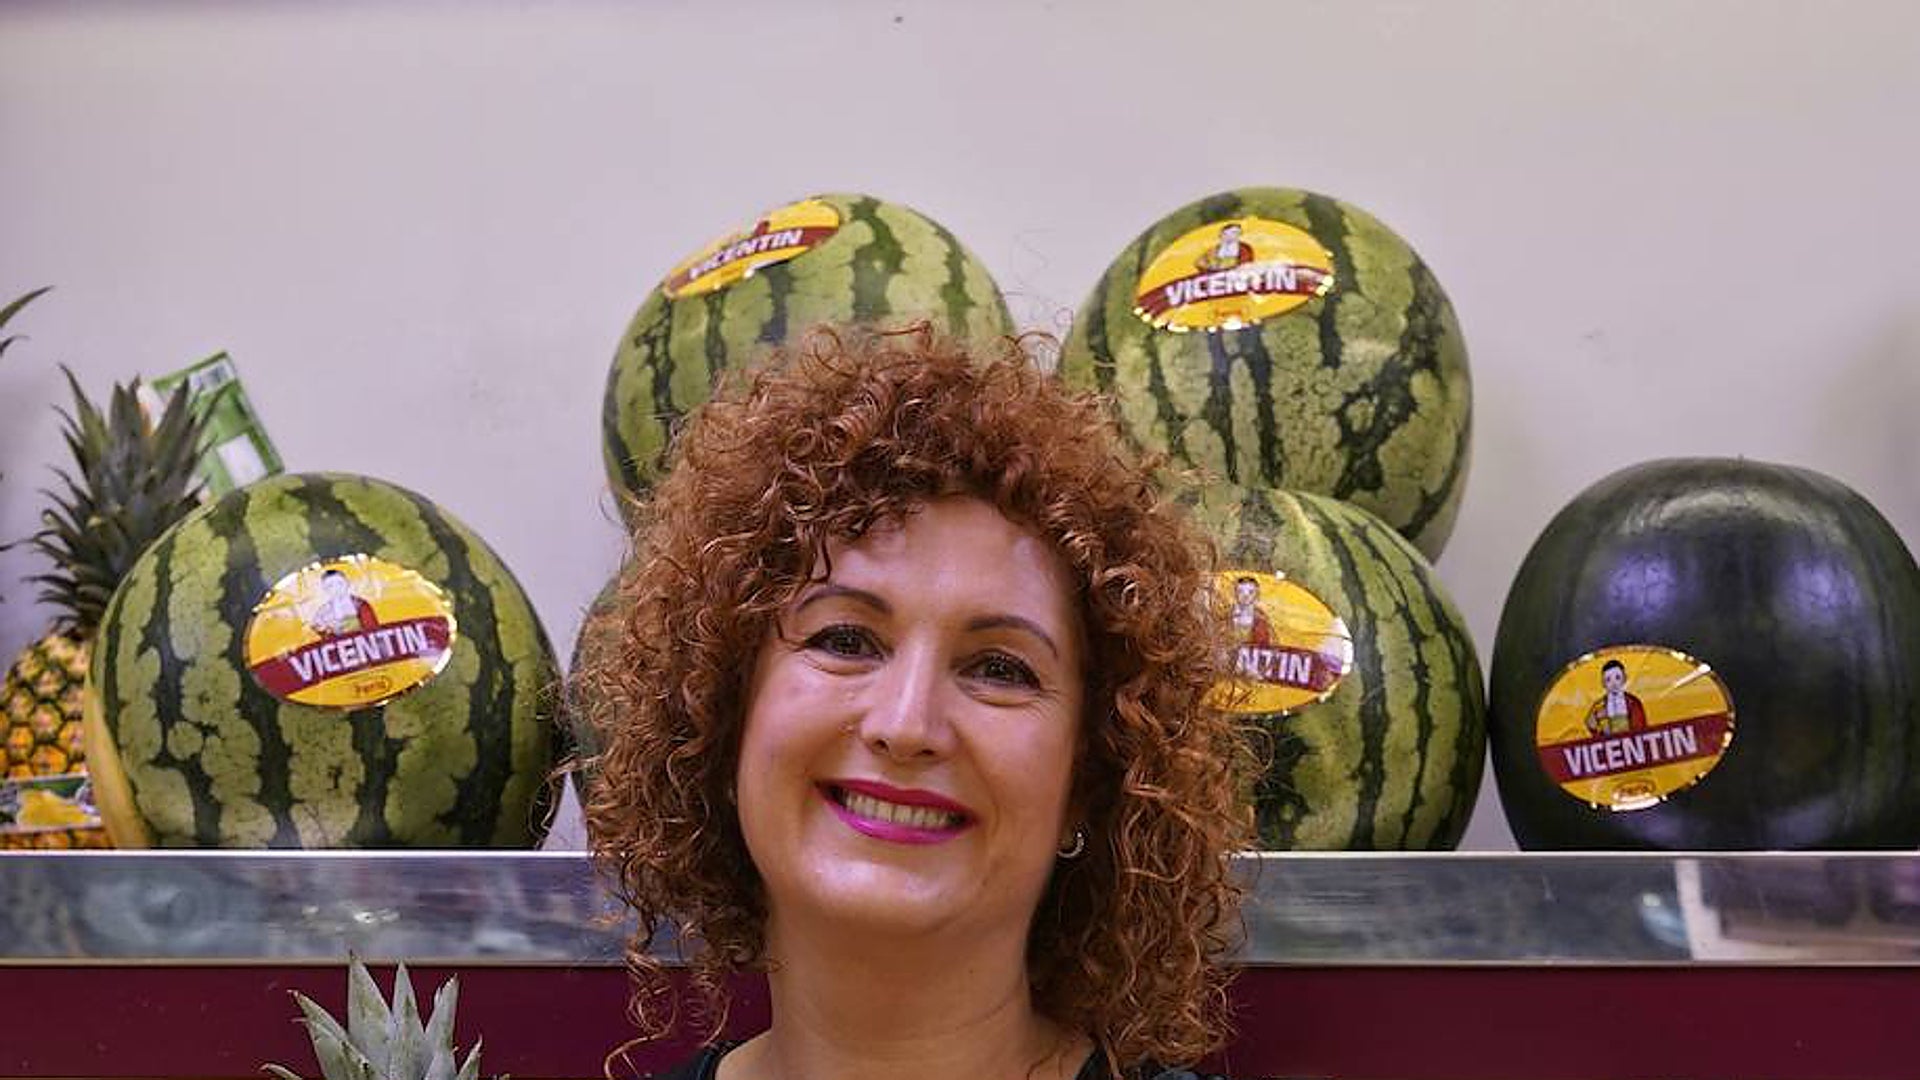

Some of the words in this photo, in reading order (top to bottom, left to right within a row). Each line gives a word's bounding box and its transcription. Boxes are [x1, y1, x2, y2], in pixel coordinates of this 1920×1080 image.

[689, 229, 803, 279] VICENTIN
[1165, 267, 1297, 305] VICENTIN
[288, 623, 428, 681] VICENTIN
[1236, 647, 1312, 685] NTIN
[1563, 725, 1697, 776] VICENTIN
